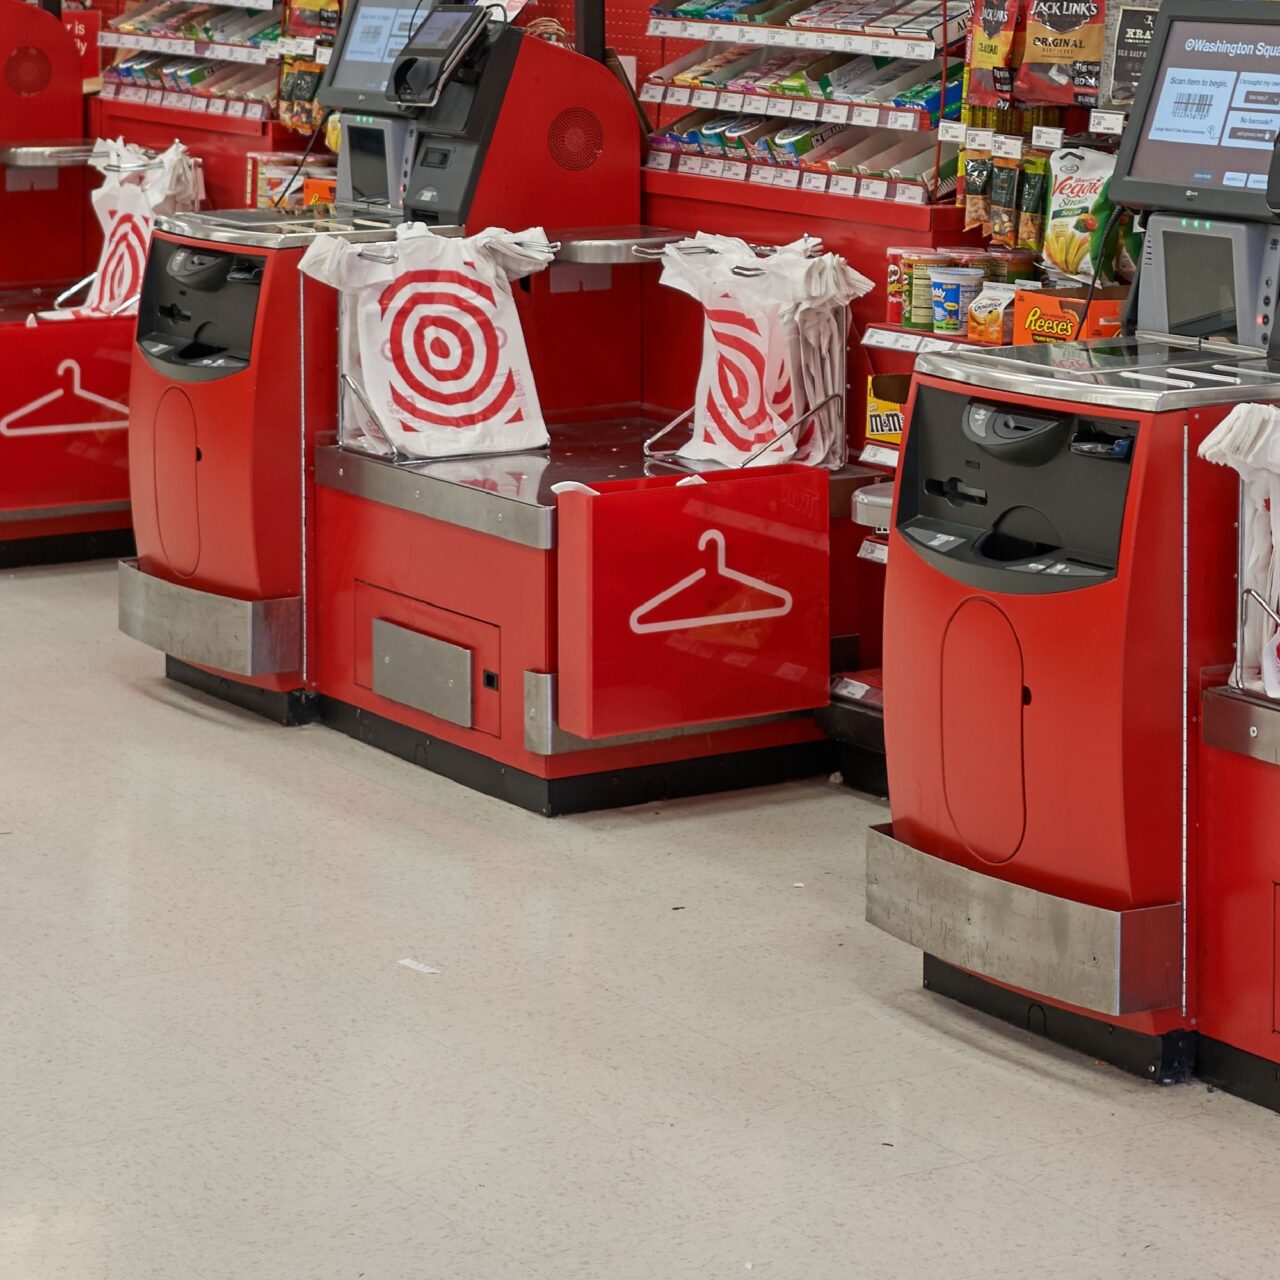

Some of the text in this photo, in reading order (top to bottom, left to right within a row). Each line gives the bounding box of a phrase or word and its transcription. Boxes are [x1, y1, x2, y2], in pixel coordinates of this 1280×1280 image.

[1030, 0, 1098, 16] JACK LINK'S
[1125, 28, 1154, 39] KRA
[1032, 36, 1086, 49] ORIGINAL
[1194, 38, 1253, 57] Washington
[1169, 76, 1228, 89] Scan item to begin.
[1242, 79, 1263, 87] brought
[1240, 116, 1248, 124] No
[1025, 306, 1073, 336] Reese's
